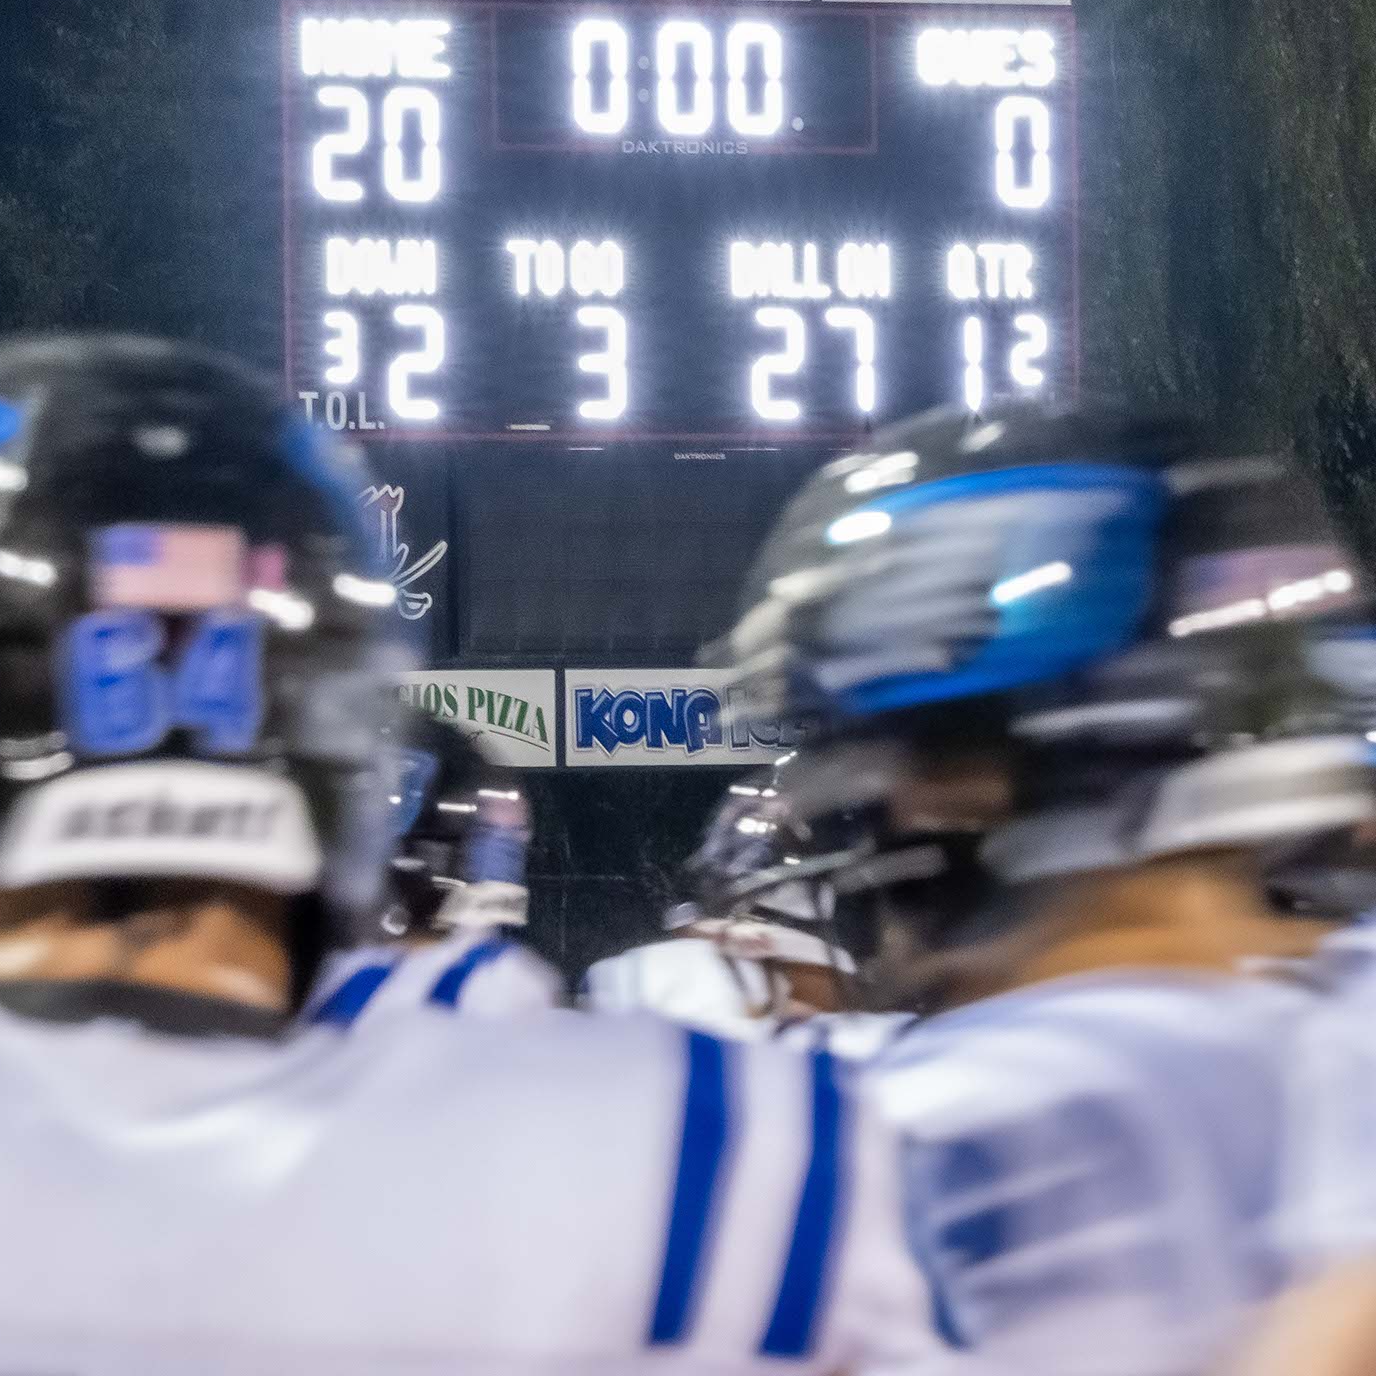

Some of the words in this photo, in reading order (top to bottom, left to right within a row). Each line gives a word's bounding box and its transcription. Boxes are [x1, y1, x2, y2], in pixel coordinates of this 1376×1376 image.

[312, 85, 442, 202] 20
[621, 140, 749, 155] DAKTRONICS
[994, 95, 1052, 209] 0
[947, 243, 1033, 299] QTR
[323, 310, 360, 384] 3
[388, 304, 446, 420] 2
[575, 305, 628, 420] 3
[750, 306, 876, 420] 27
[1009, 313, 1048, 386] 2
[298, 391, 386, 431] TO.L.
[467, 686, 549, 745] PIZZA
[572, 686, 725, 756] KONA
